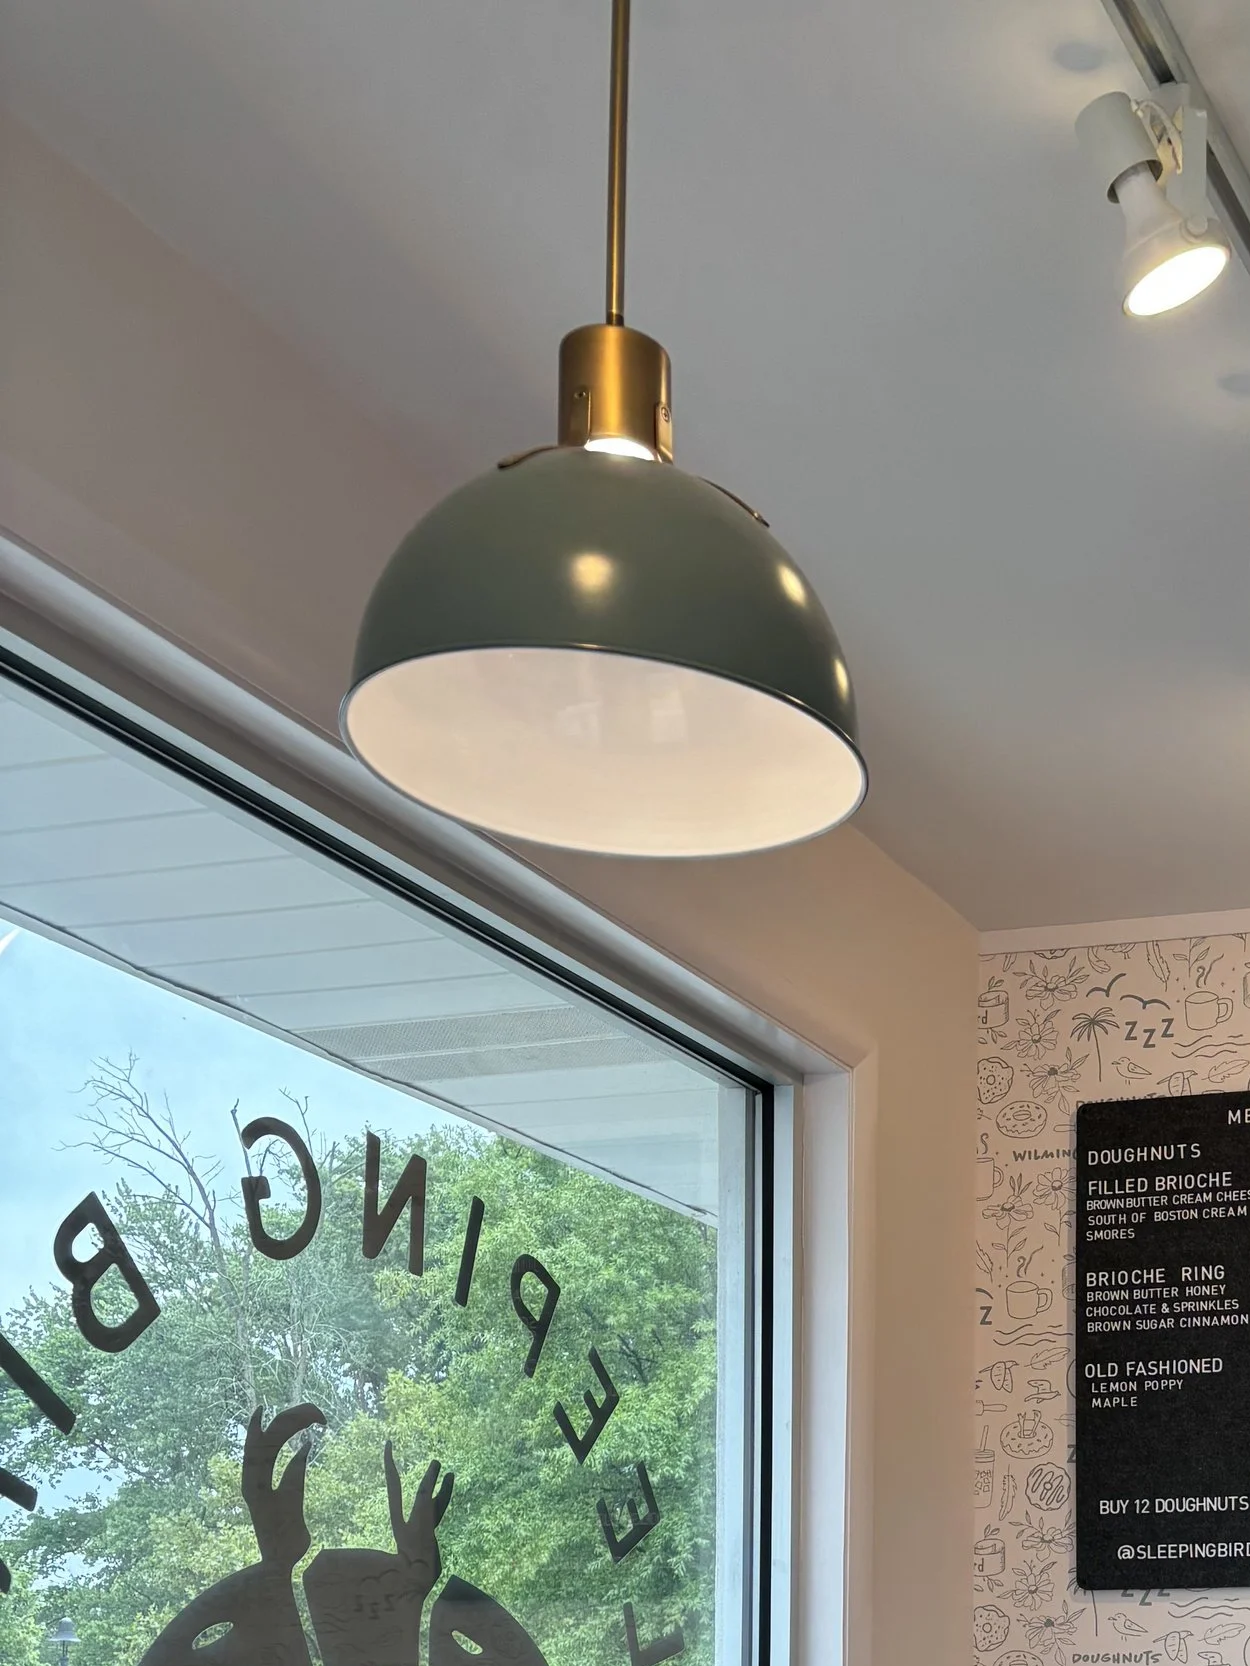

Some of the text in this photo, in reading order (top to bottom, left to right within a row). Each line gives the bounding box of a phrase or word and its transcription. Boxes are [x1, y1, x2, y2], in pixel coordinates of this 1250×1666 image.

[1088, 1143, 1202, 1165] DOUGHNUTS
[1088, 1177, 1149, 1196] FILLED
[1155, 1171, 1233, 1192] BRIOCHE
[1172, 1192, 1214, 1205] CREAM
[1088, 1205, 1248, 1226] SOUTH OF BOSTON CREAM
[1086, 1228, 1135, 1242] SMORES
[1086, 1268, 1166, 1287] BRIOCHE
[1181, 1265, 1225, 1282] RING
[1086, 1284, 1226, 1302] BROWN BUTTER HONEY
[1085, 1299, 1240, 1318] CHOCOLATE & SPRINKLES
[1087, 1314, 1250, 1333] BROWN SUGAR CINNAMON
[1084, 1363, 1119, 1379] OLD
[1126, 1357, 1223, 1376] FASHIONED
[1091, 1378, 1184, 1394] LEMON POPPY
[1091, 1395, 1138, 1409] MAPLE
[1099, 1499, 1130, 1515] BUY
[1134, 1499, 1150, 1514] 12
[1155, 1495, 1250, 1514] DOUGHNUTS
[1072, 1650, 1163, 1666] DOUGHNUTS
